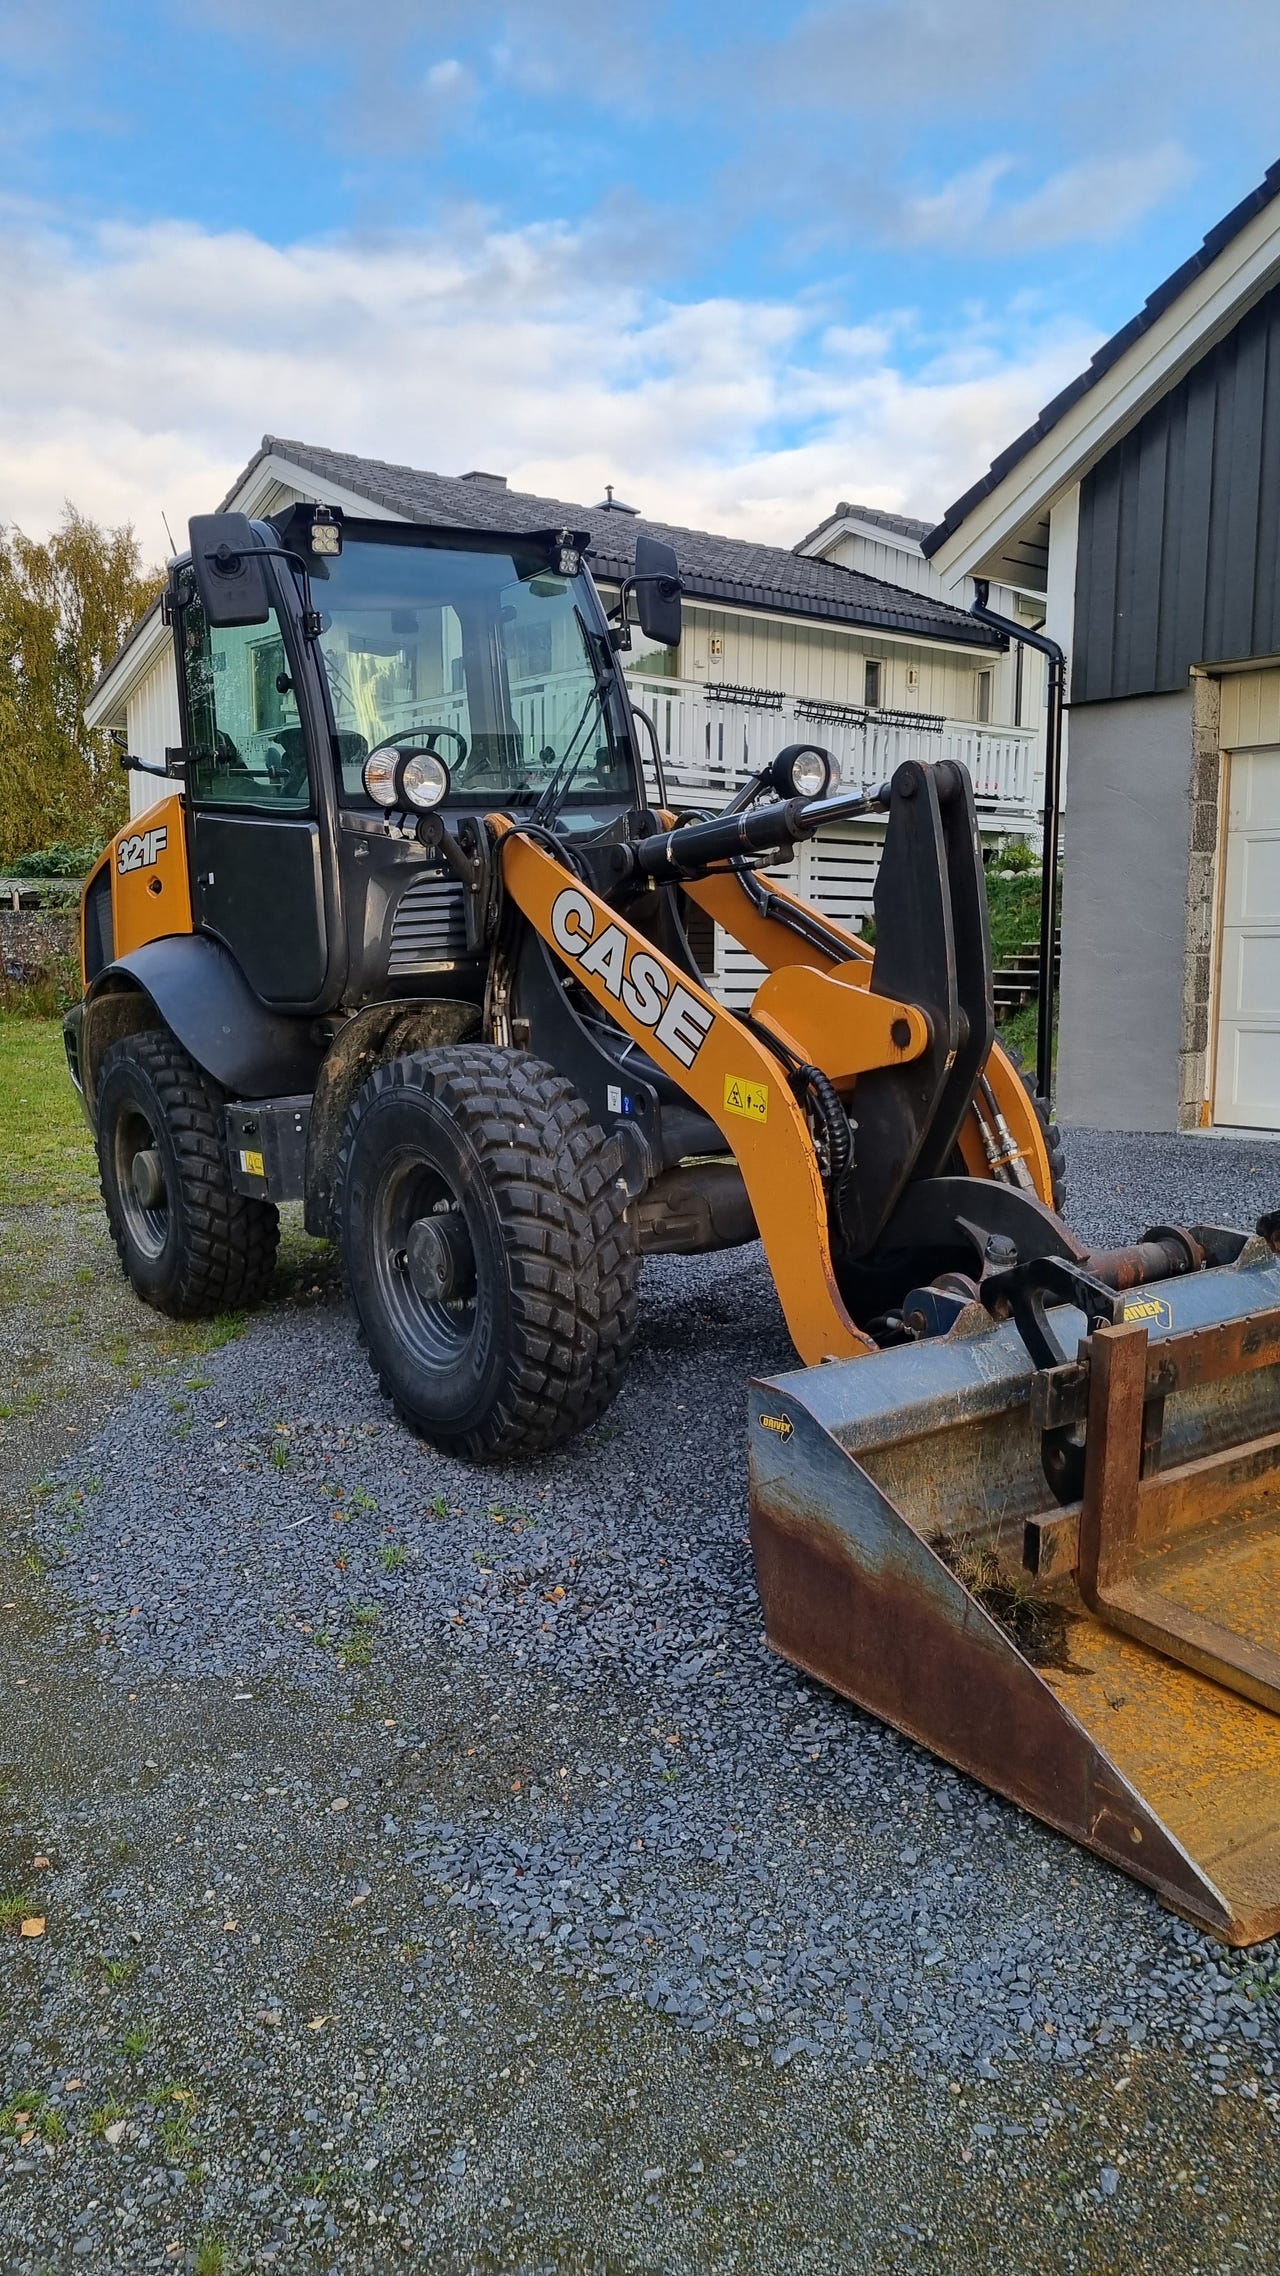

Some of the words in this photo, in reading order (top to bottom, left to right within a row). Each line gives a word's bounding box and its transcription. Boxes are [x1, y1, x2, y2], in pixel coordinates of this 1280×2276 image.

[117, 826, 168, 875] 321F
[551, 888, 716, 1070] CASE
[1123, 1301, 1165, 1321] RIVEX
[763, 1417, 791, 1433] DRIVEX
